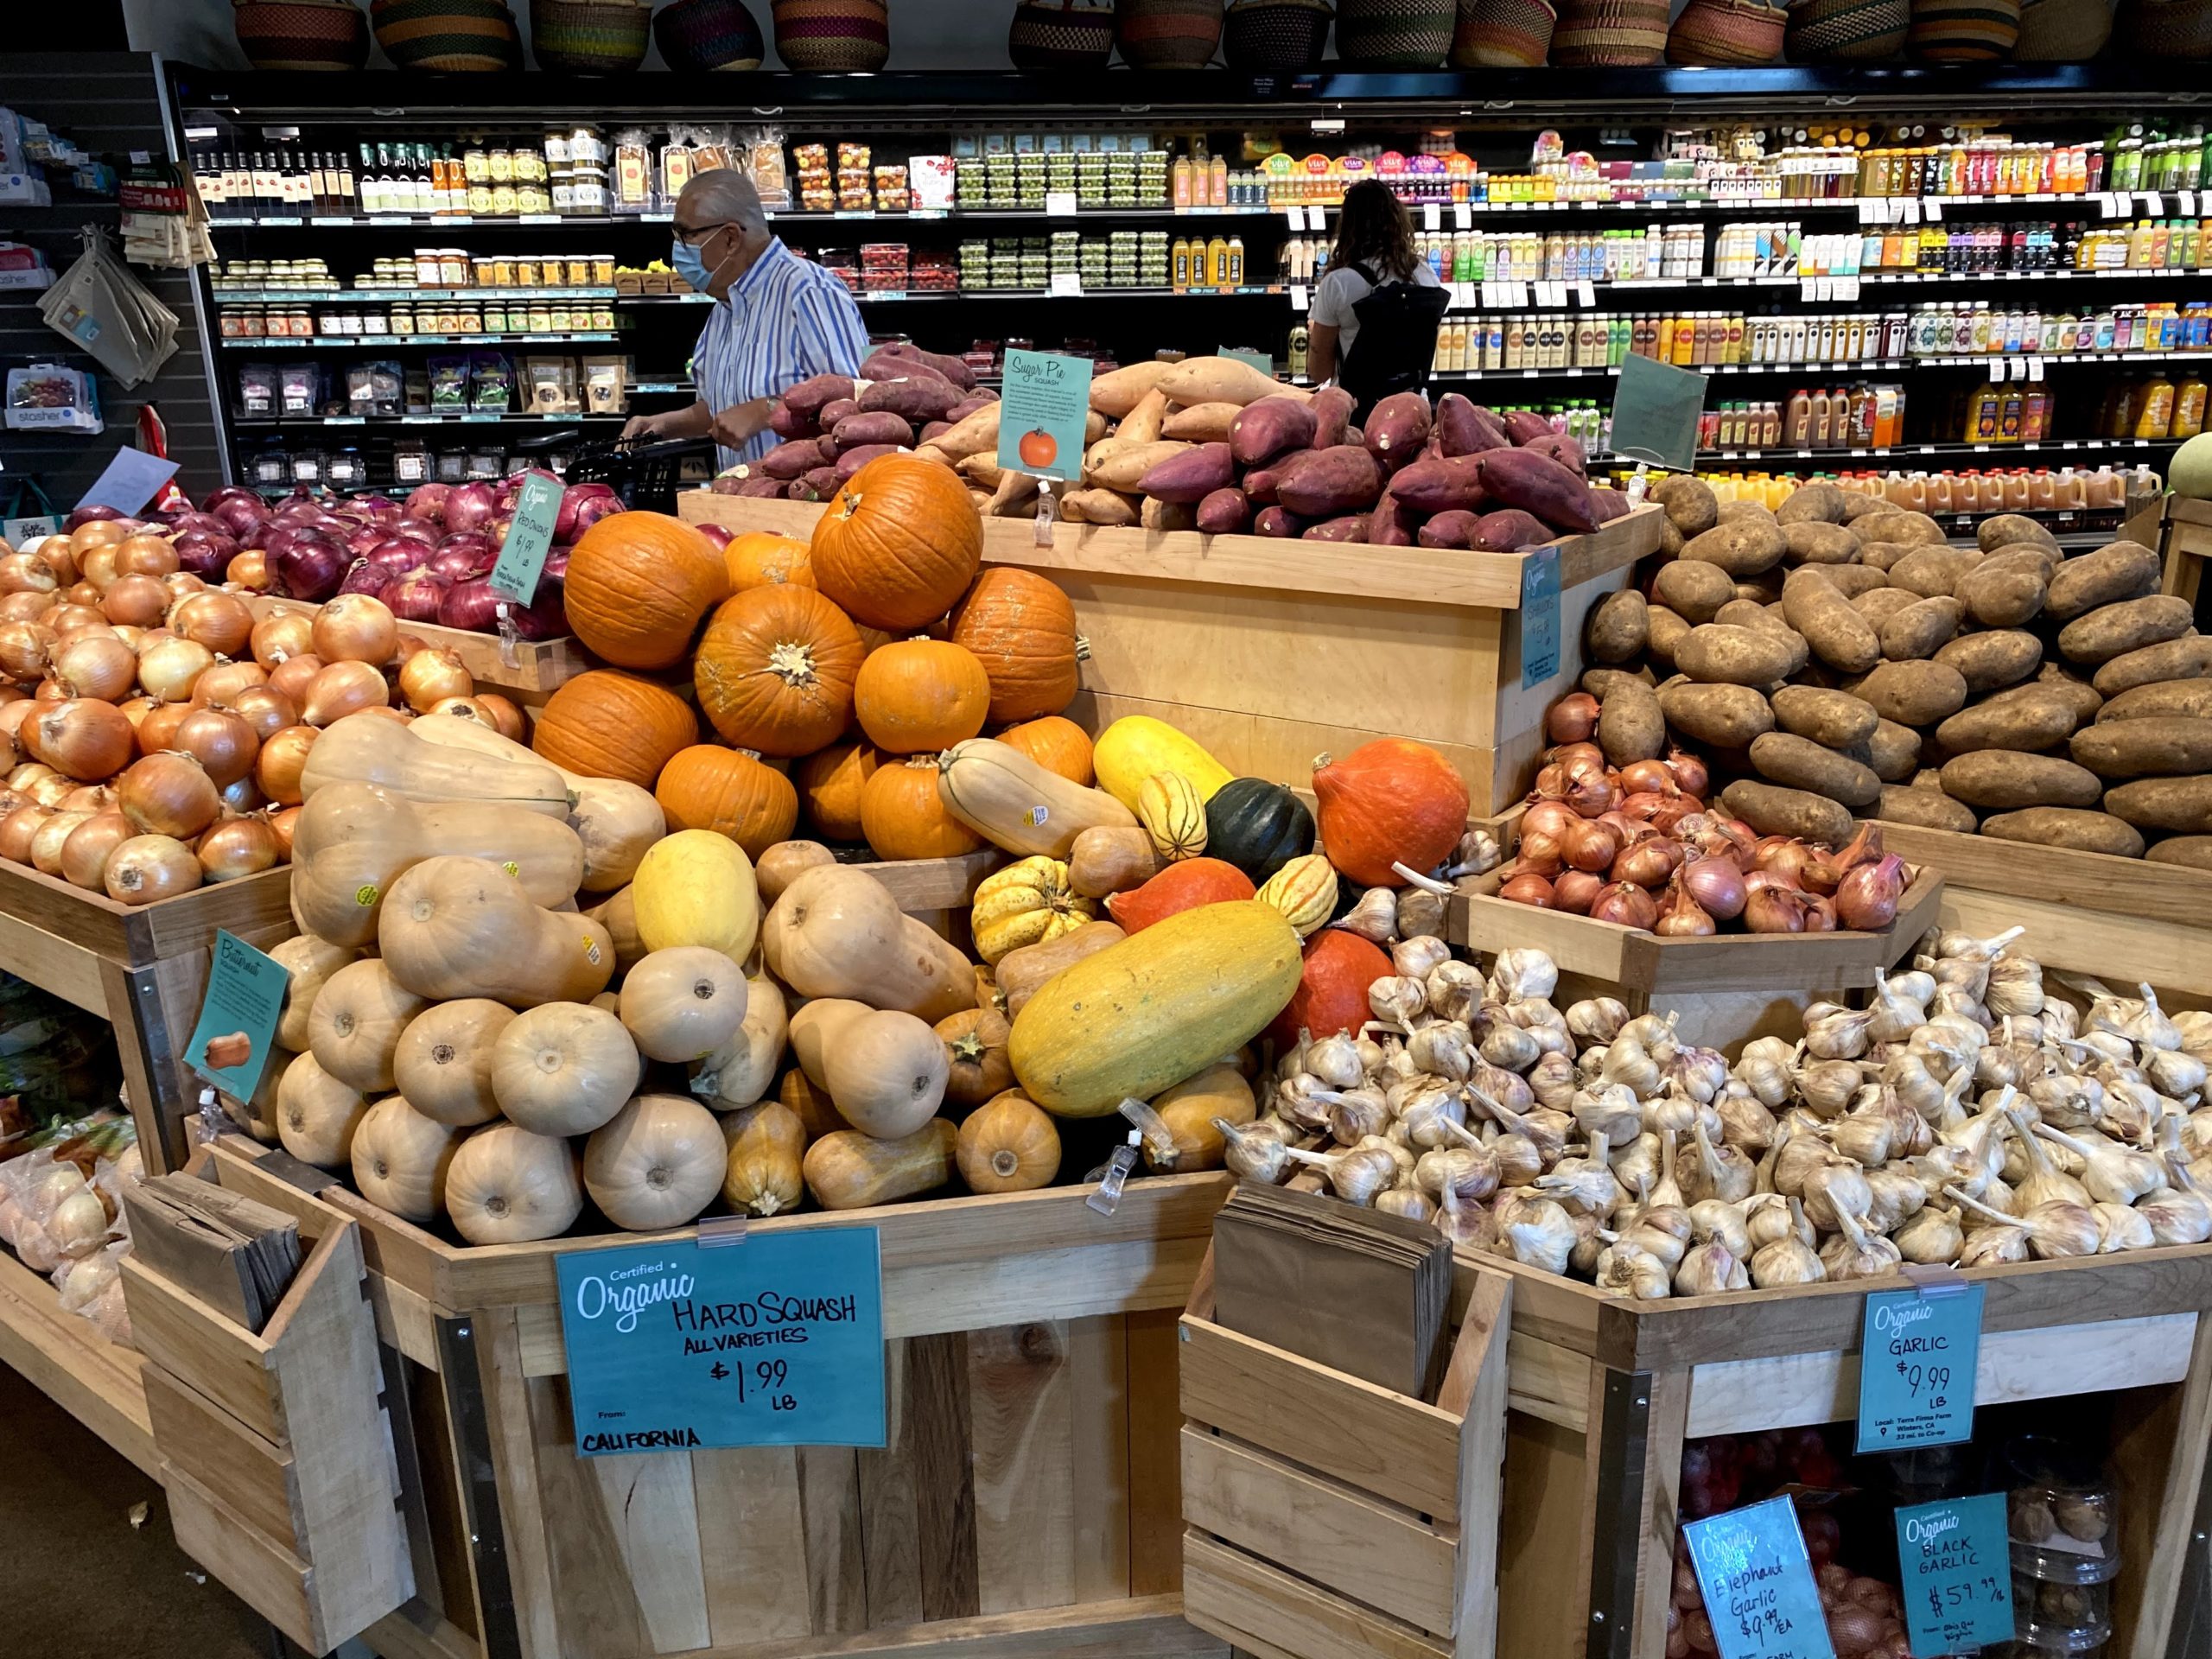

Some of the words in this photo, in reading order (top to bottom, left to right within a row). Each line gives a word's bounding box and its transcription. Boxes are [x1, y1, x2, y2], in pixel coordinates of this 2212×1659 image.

[1011, 356, 1042, 383] Sugar
[1046, 360, 1065, 379] Pie
[19, 410, 60, 422] stasher
[610, 1261, 664, 1281] Certified
[577, 1262, 695, 1332] Organic
[672, 1300, 758, 1332] HARD
[756, 1291, 856, 1325] SQUASH
[1874, 1300, 1933, 1338] Organic
[683, 1337, 715, 1356] ALL
[713, 1327, 808, 1351] VARIETIES
[1889, 1337, 1948, 1356] GARLIC
[710, 1359, 788, 1403] $1.99
[1897, 1360, 1950, 1398] $9.99
[772, 1395, 797, 1410] LB
[1929, 1396, 1947, 1409] LB
[582, 1427, 701, 1452] CALIFORNIA
[1906, 1510, 1959, 1549] Organic
[1922, 1535, 1973, 1558] BLACK
[1713, 1555, 1783, 1598] Elephant
[1919, 1553, 1979, 1574] GARLIC
[1731, 1588, 1777, 1620] Garlic
